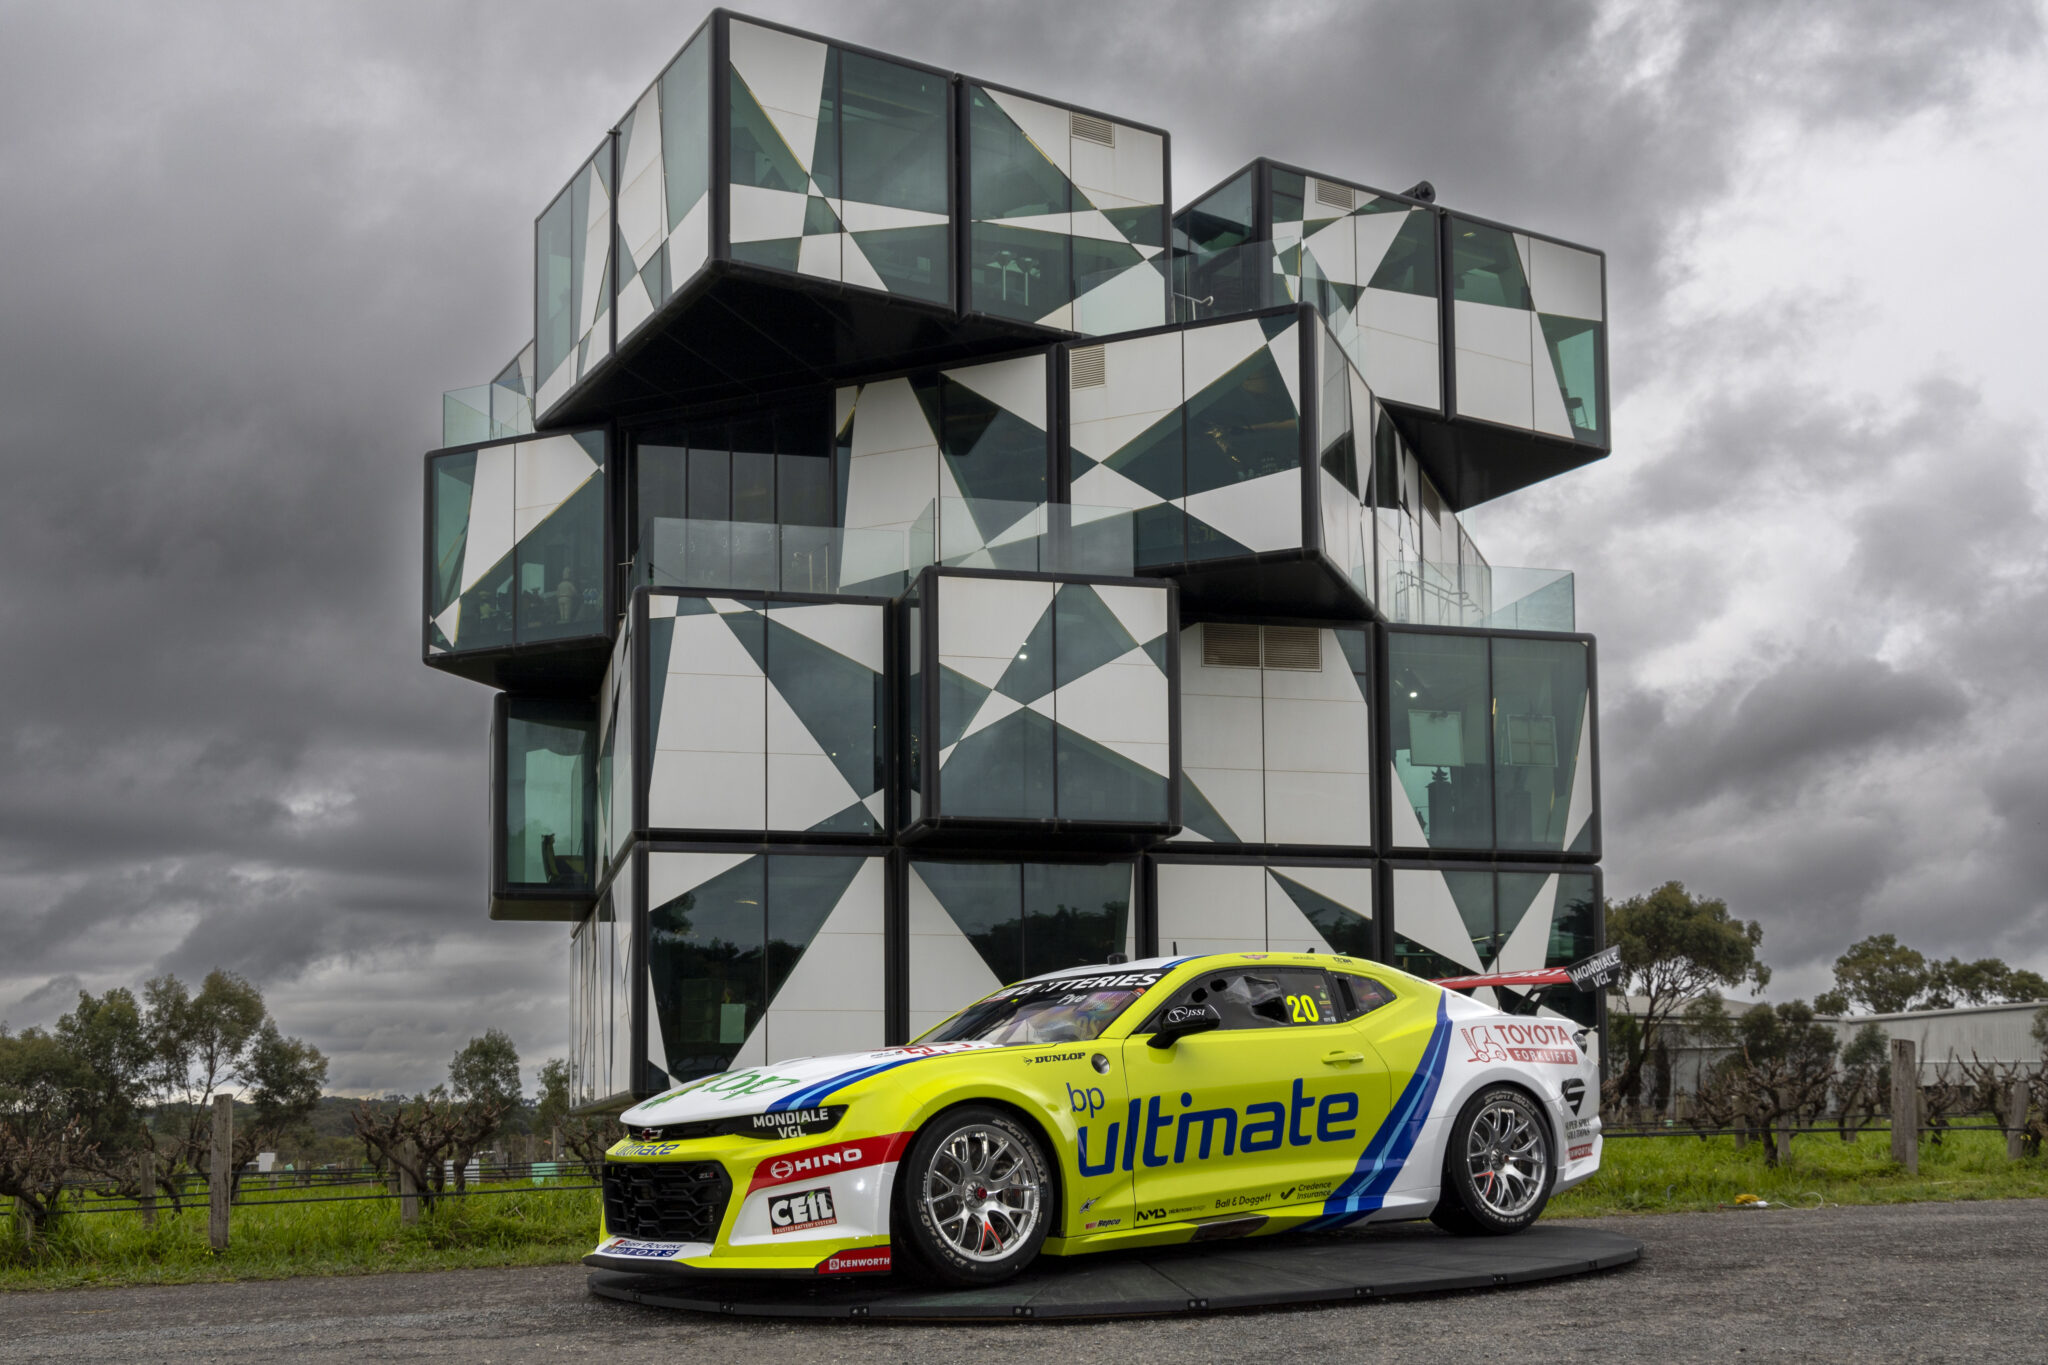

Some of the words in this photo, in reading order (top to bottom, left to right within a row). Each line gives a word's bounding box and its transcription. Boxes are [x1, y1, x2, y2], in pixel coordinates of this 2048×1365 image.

[1573, 951, 1621, 982] MONDIALE
[1591, 974, 1612, 988] VGL
[1056, 993, 1089, 1006] Pye
[1187, 1008, 1206, 1018] JSSI
[1286, 994, 1319, 1023] 20
[1493, 1024, 1574, 1046] TOYOTA
[1034, 1052, 1086, 1064] DUNLOP
[1514, 1049, 1575, 1063] FORKLIFTS
[1065, 1082, 1105, 1119] bp
[752, 1108, 829, 1128] MONDIALE
[777, 1125, 807, 1139] VGL
[1077, 1077, 1360, 1178] ultimate
[794, 1147, 863, 1173] HINO
[1298, 1180, 1332, 1192] Credence
[1215, 1199, 1231, 1209] Ball
[1238, 1192, 1271, 1208] Doggett
[1296, 1188, 1333, 1201] Insurance
[1097, 1217, 1121, 1228] Repco
[611, 1247, 676, 1257] MOTORS
[840, 1257, 890, 1269] KENWORTH
